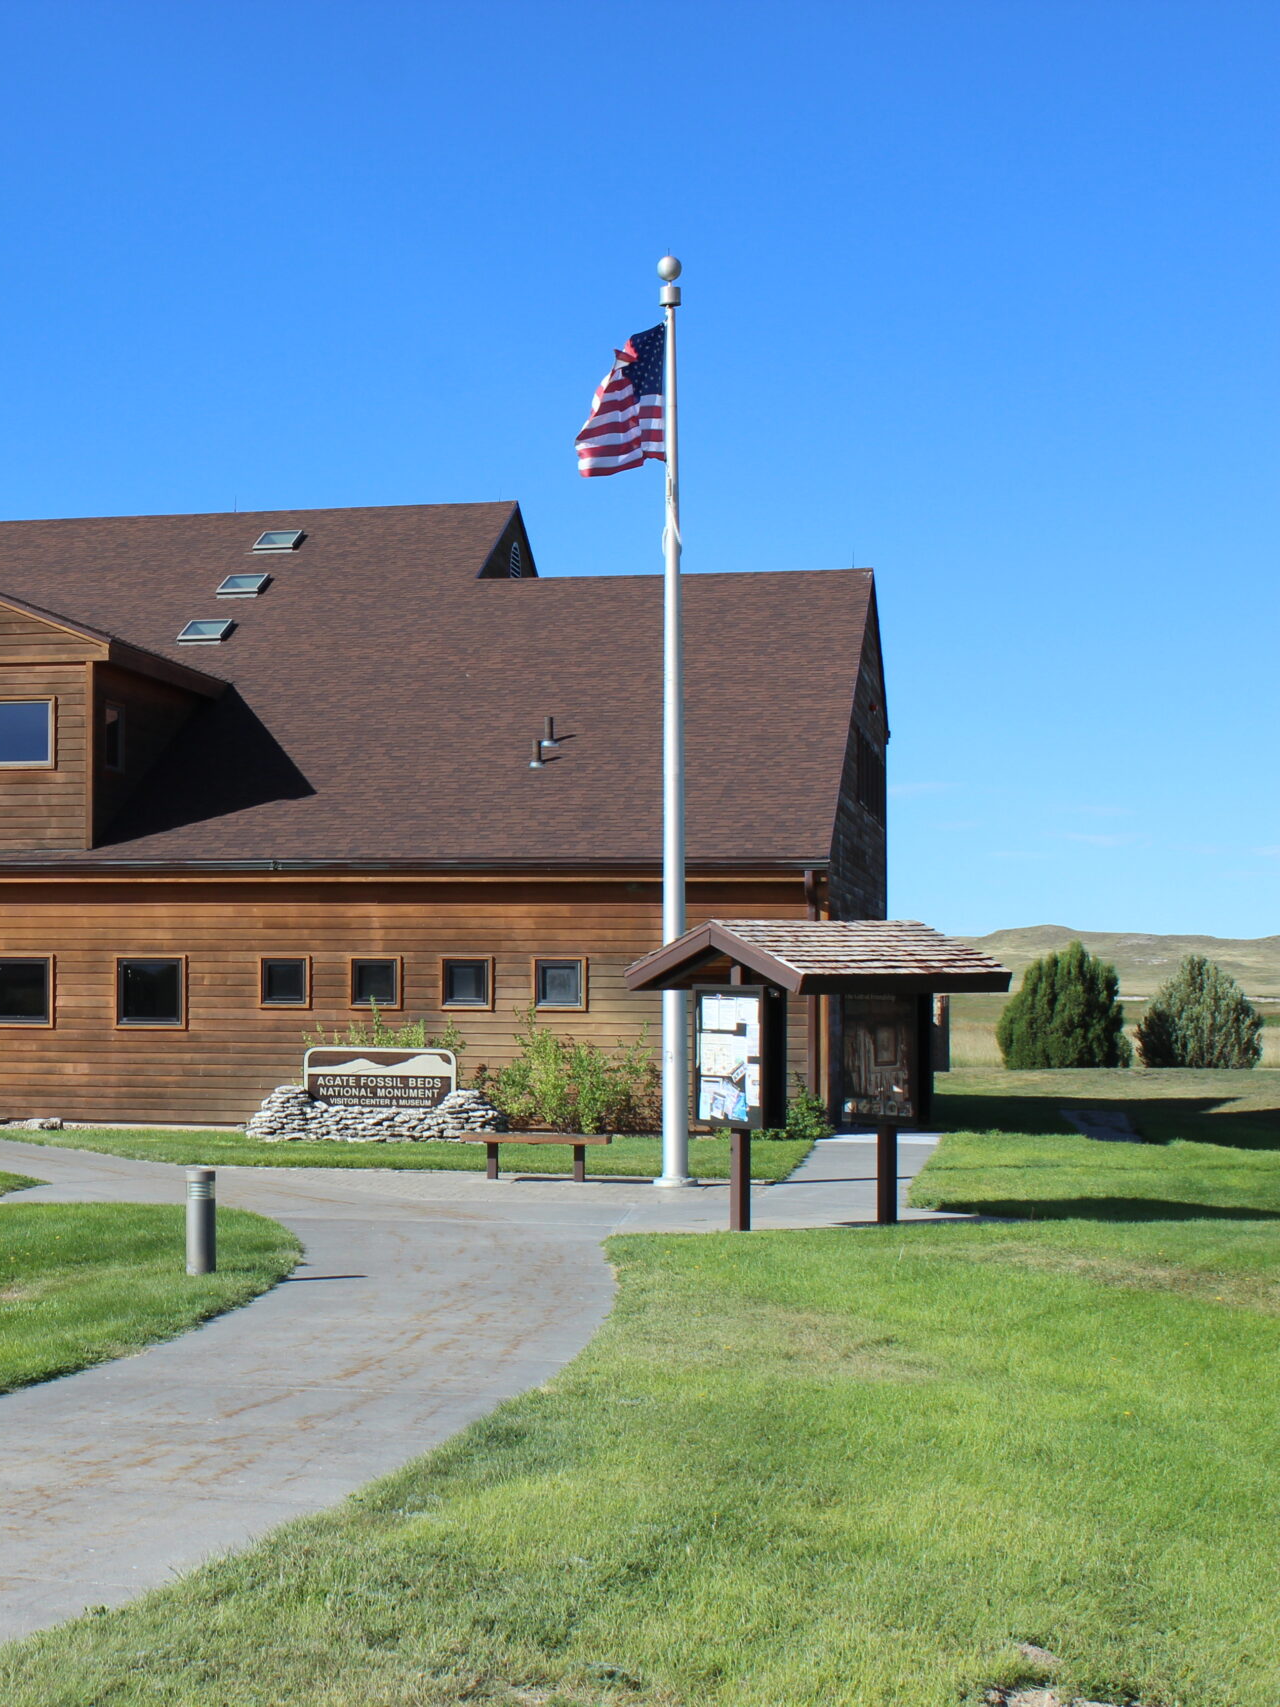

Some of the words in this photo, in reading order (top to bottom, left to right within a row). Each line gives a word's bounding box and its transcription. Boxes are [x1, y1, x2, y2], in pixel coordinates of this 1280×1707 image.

[317, 1076, 356, 1086] AGATE
[360, 1077, 404, 1087] FOSSIL
[408, 1078, 442, 1088] BEDS
[320, 1087, 373, 1097] NATIONAL
[377, 1087, 439, 1098] MONUMENT
[329, 1097, 359, 1105] VISITOR
[360, 1098, 391, 1106] CENTER
[392, 1098, 397, 1106] &
